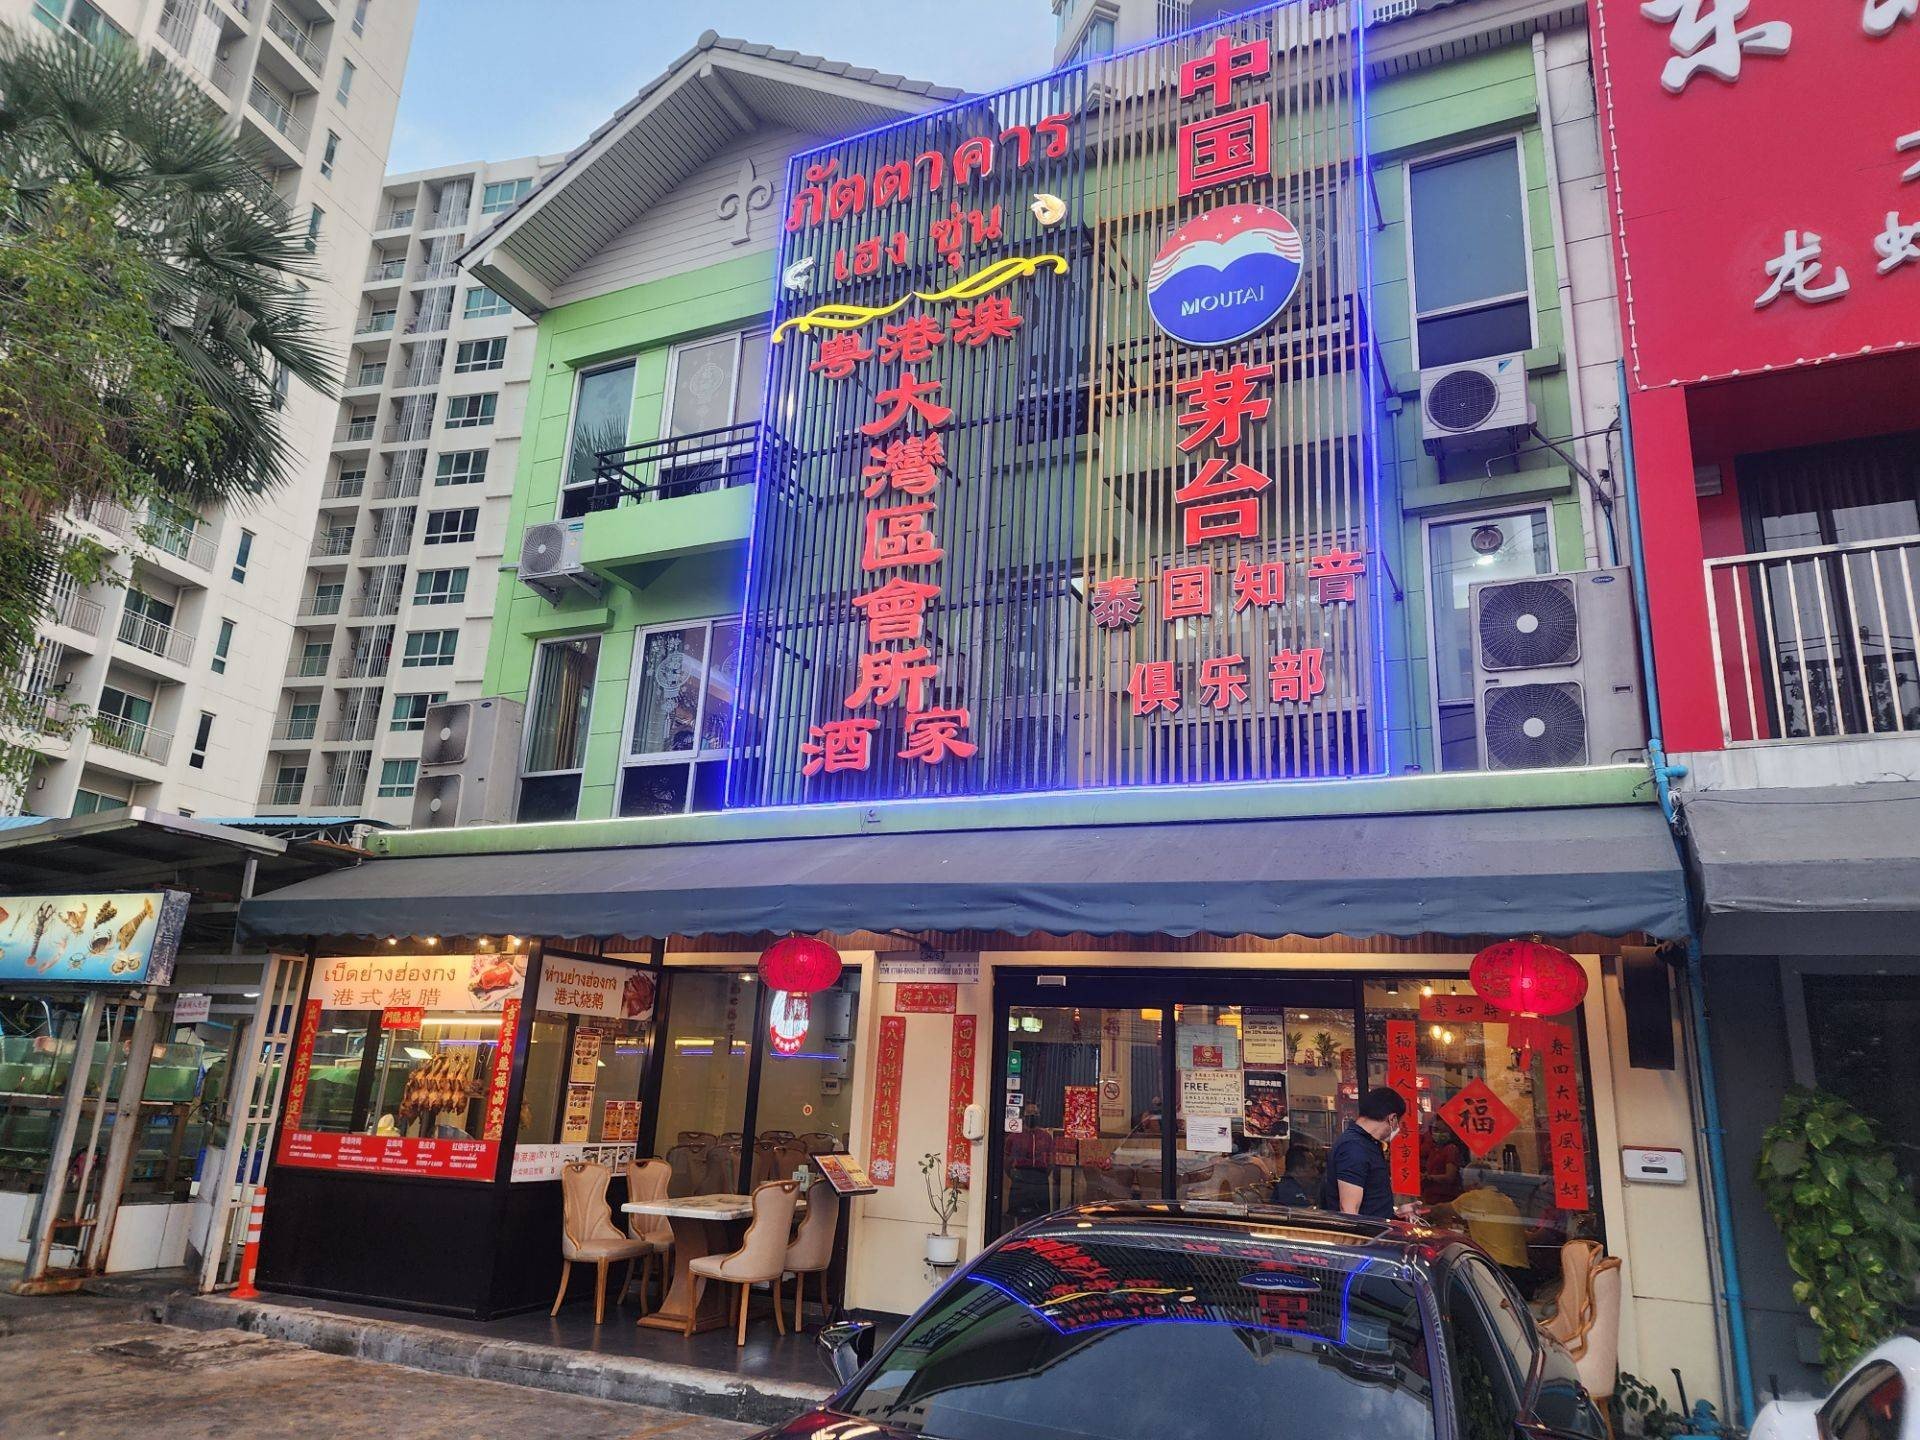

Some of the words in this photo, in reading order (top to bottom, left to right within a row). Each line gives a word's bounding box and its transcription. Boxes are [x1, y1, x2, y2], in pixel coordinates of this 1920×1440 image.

[1177, 35, 1272, 199] 中国
[785, 111, 1073, 234] ภัตตาคาร
[1181, 284, 1265, 317] MOUTAI
[1174, 362, 1274, 548] 茅台
[1092, 547, 1368, 630] 泰国知音
[1126, 647, 1328, 719] 俱乐部
[799, 706, 979, 777] 酒家
[323, 961, 457, 983] เป็ดย่างฮ่องกง
[332, 987, 442, 1007] 港式烧腊
[544, 964, 618, 991] ห่านย่างฮ่องกง
[1184, 1082, 1209, 1091] FREE
[1458, 1097, 1497, 1134] 福
